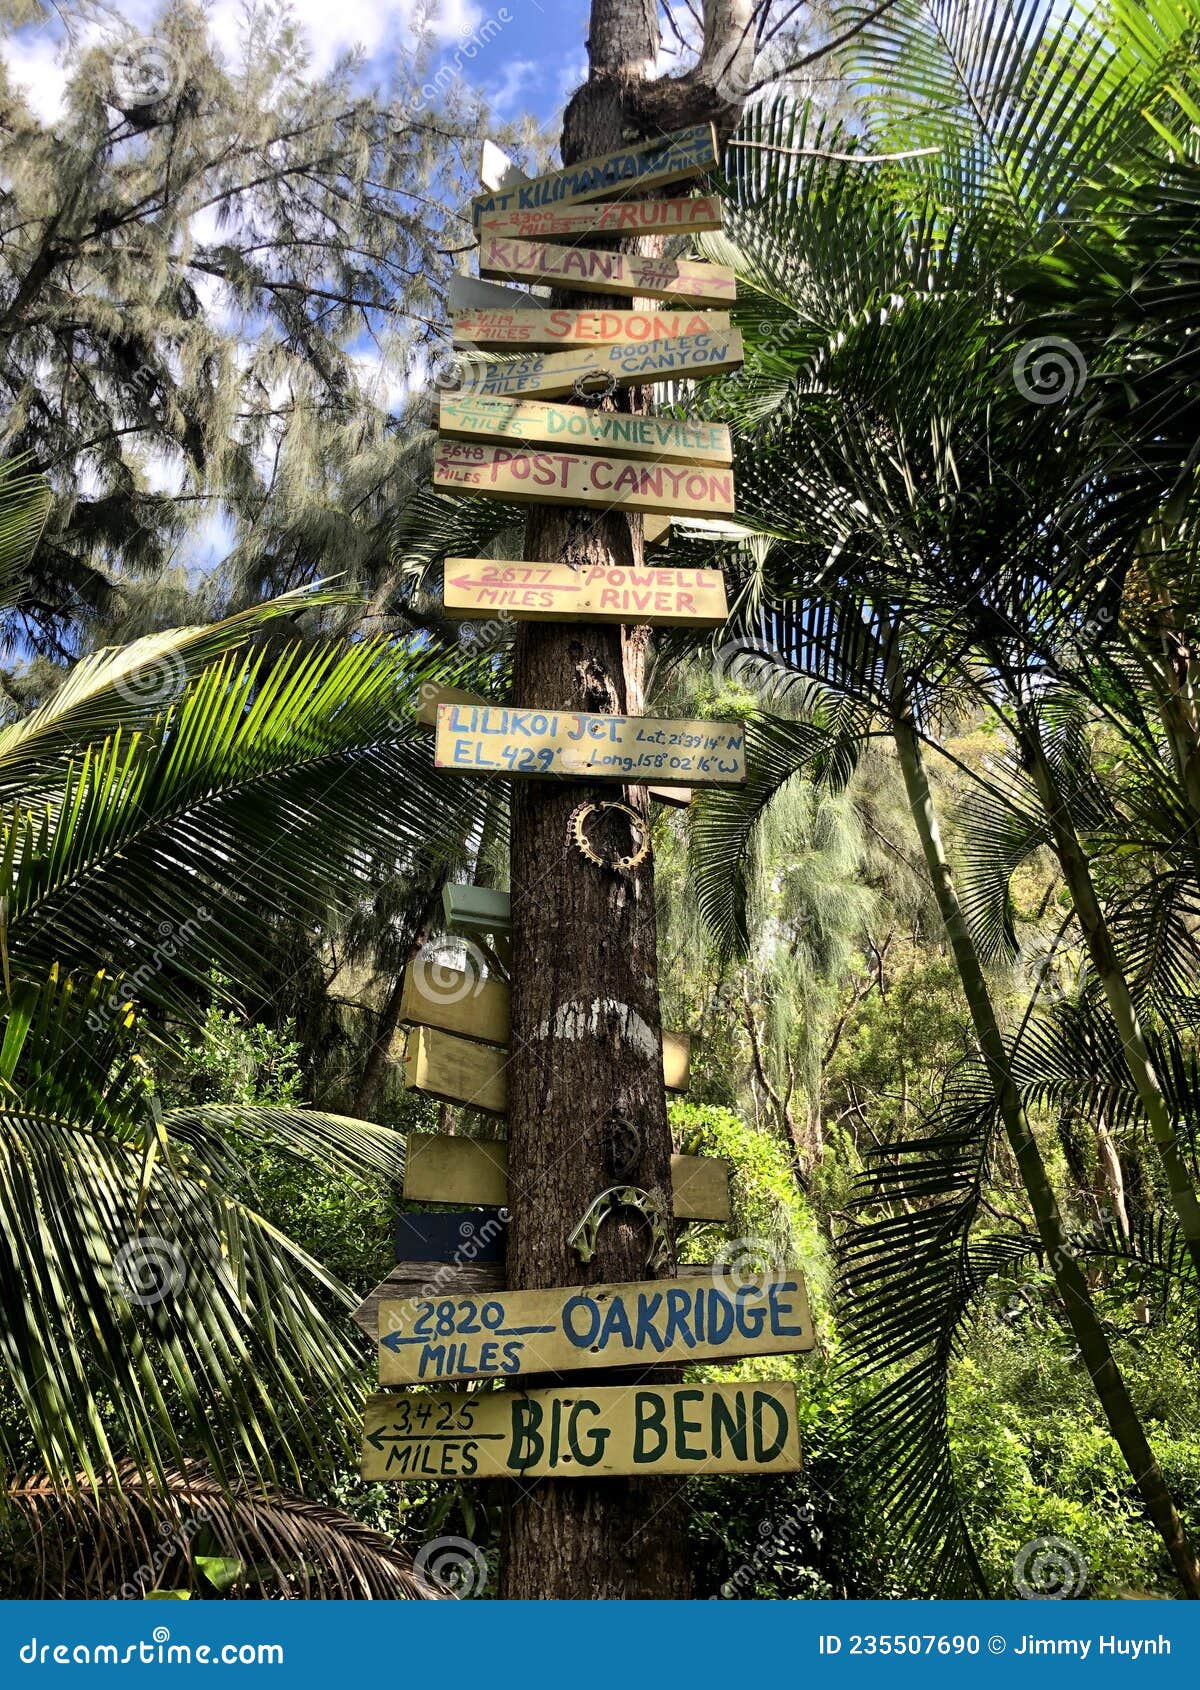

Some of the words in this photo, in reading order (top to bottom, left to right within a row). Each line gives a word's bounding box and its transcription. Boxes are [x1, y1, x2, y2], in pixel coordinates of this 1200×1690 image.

[517, 218, 572, 236] MILES
[599, 198, 716, 230] FRUITA
[487, 239, 623, 281] KULANI
[474, 326, 531, 340] MILES
[544, 310, 709, 341] SEDONA
[609, 334, 712, 361] BOOTLEG
[621, 345, 728, 373] CANYON
[480, 376, 541, 396] MILES
[460, 415, 523, 436] MILES
[546, 409, 726, 451] DOWNIEVILLE
[436, 467, 481, 484] MILES
[490, 449, 579, 489] POST
[589, 461, 731, 504] CANYON
[585, 566, 716, 589] POWELL
[476, 587, 555, 608] MILES
[599, 588, 698, 614] RIVER
[449, 707, 559, 738] LILIKOI
[567, 714, 627, 744] JCT.
[561, 1281, 803, 1352] OAKRIDGE
[418, 1341, 525, 1378] MILES
[506, 1398, 612, 1470] BIG
[632, 1389, 789, 1464] BEND
[384, 1441, 479, 1477] MILES
